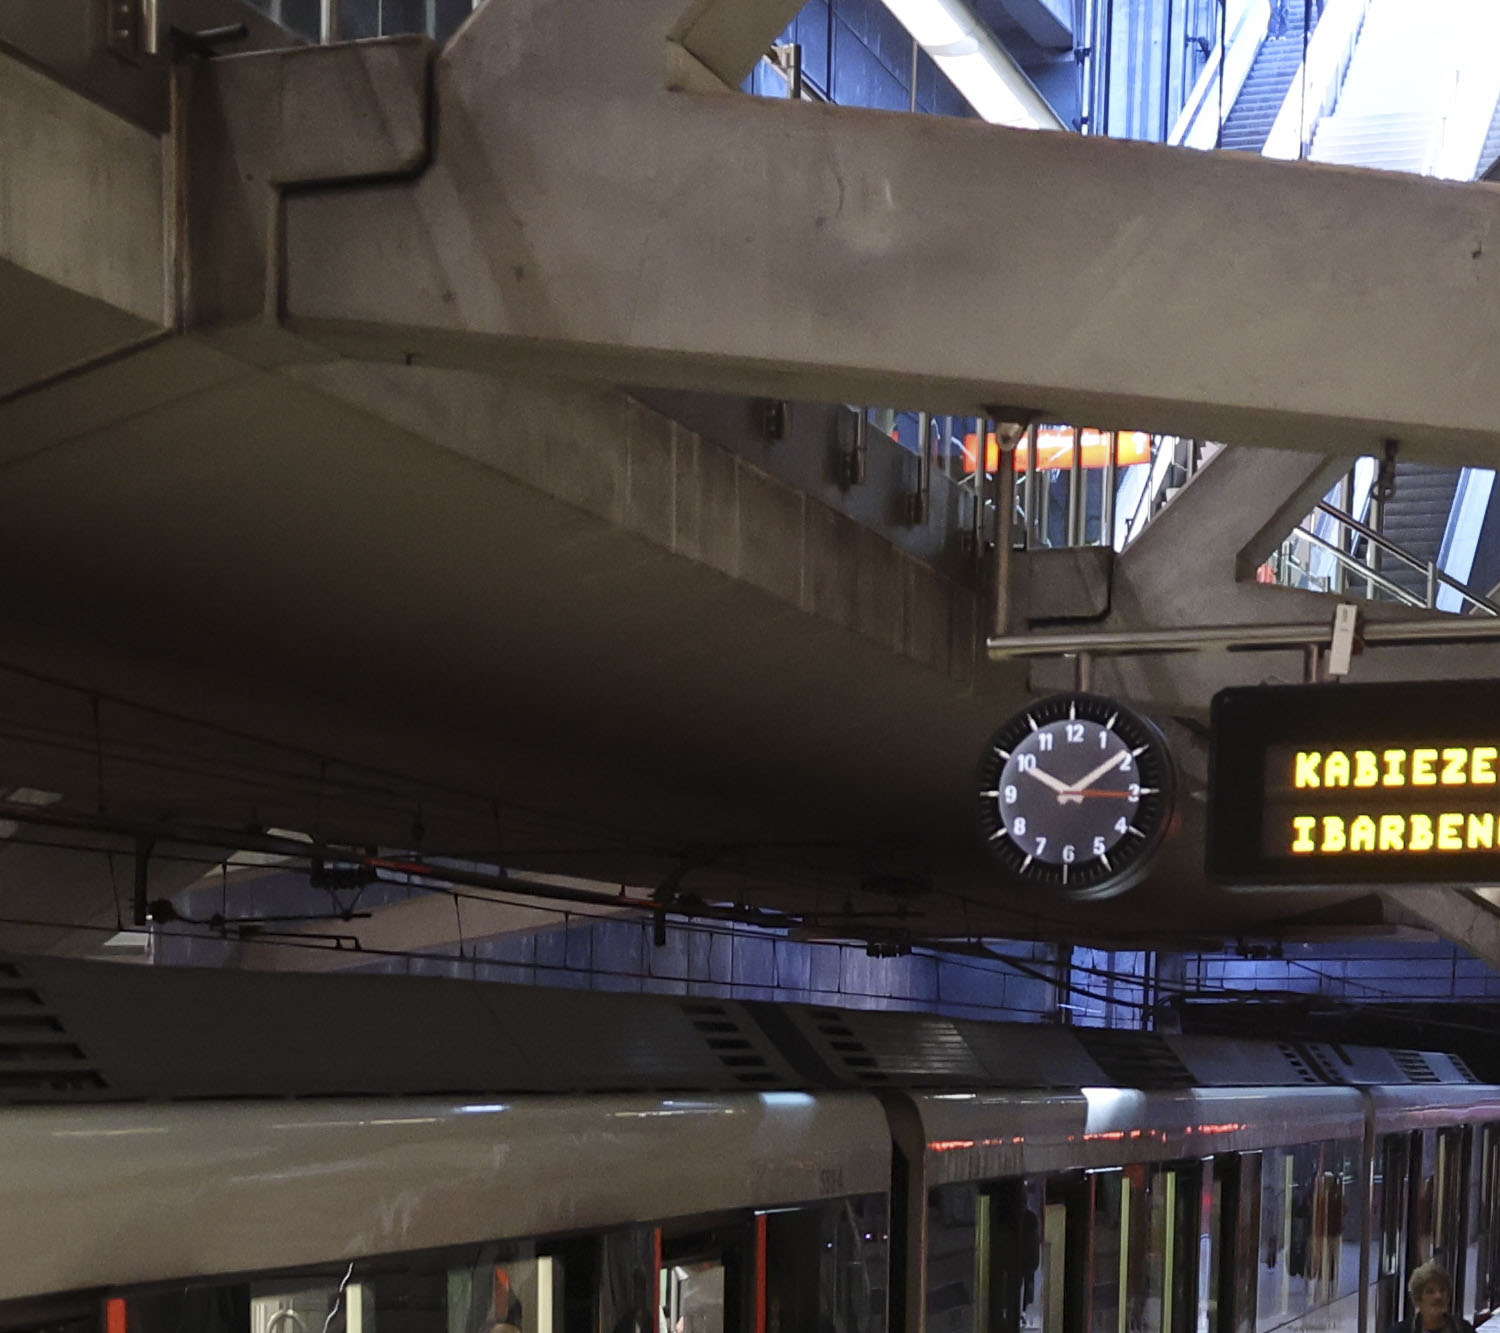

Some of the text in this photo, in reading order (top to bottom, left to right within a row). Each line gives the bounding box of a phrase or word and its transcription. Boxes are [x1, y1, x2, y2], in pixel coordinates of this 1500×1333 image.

[1038, 732, 1054, 751] 11
[1065, 723, 1085, 743] 12
[1099, 730, 1108, 749] 1
[1017, 753, 1037, 773] 10
[1119, 752, 1133, 771] 2
[1004, 785, 1018, 804] 9
[1127, 783, 1140, 802] 3
[1013, 816, 1026, 836] 8
[1114, 816, 1128, 834] 4
[1035, 837, 1047, 855] 7
[1063, 845, 1075, 863] 6
[1093, 836, 1106, 855] 5
